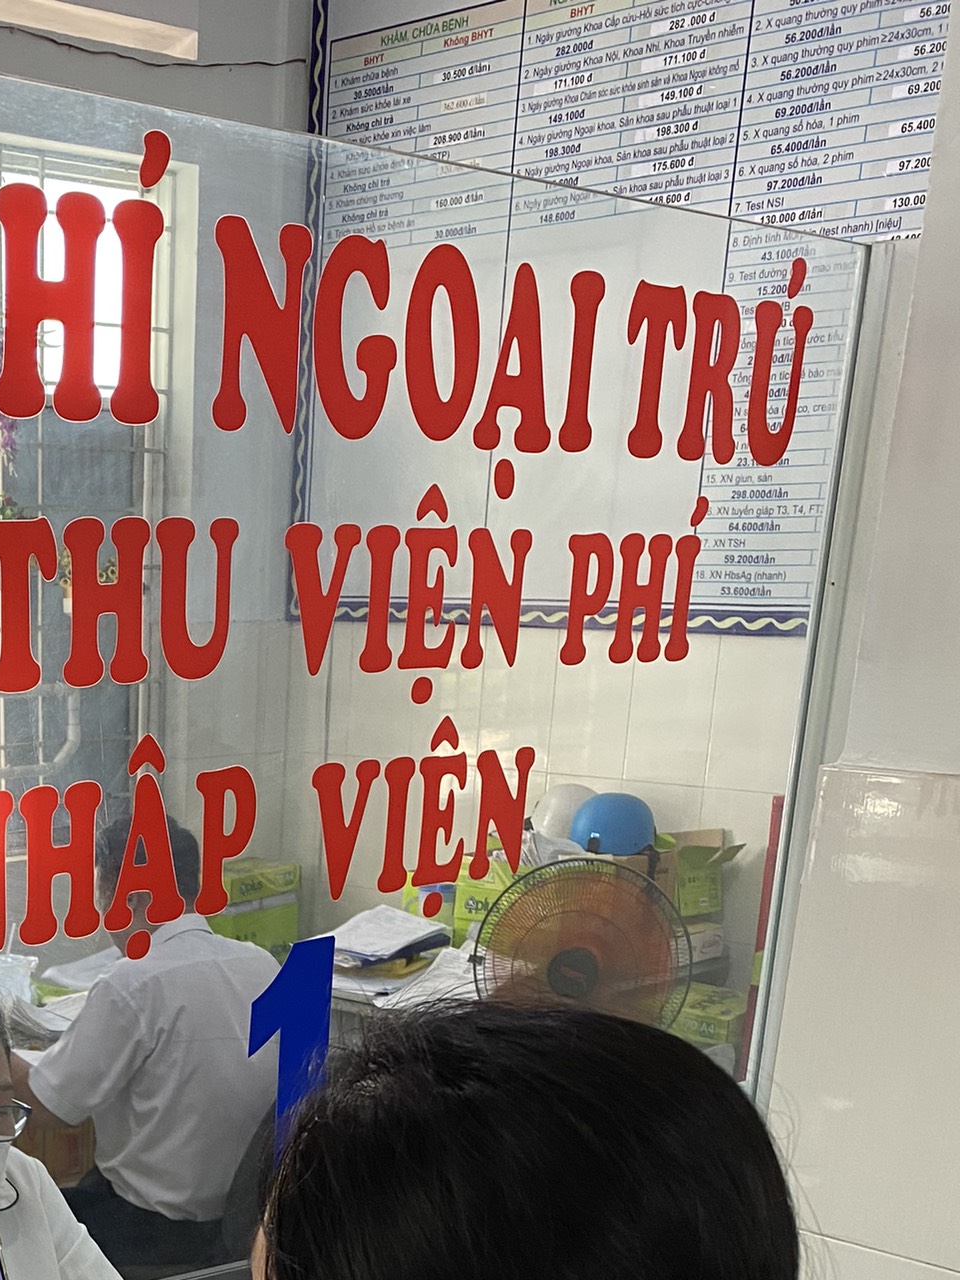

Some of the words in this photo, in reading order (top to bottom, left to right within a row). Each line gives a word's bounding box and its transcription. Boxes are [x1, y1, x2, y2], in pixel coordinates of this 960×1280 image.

[570, 5, 595, 18] BHYT
[708, 11, 716, 22] đ
[443, 35, 469, 48] Không
[471, 28, 494, 41] BHYT
[785, 26, 842, 44] 56.200đ/lần
[556, 40, 593, 57] 282.000đ
[364, 54, 384, 66] BHYT
[663, 52, 697, 66] 171.100
[699, 49, 706, 59] đ
[442, 68, 466, 81] 30.500
[780, 63, 837, 81] 56.200đ/lần
[554, 75, 585, 89] 171.100
[587, 73, 593, 82] đ
[660, 87, 694, 102] 149.100
[696, 85, 703, 94] đ
[548, 109, 585, 124] 149.100đ
[775, 101, 832, 118] 69.200đ/lần
[656, 123, 690, 138] 198.300
[692, 121, 698, 130] đ
[901, 119, 935, 133] 65.400
[545, 144, 581, 158] 198.300đ
[770, 138, 826, 155] 65.400đ/lần
[653, 159, 686, 172] 175.600
[688, 157, 694, 166] đ
[766, 176, 822, 191] 97.200đ/lần
[746, 200, 764, 211] Test
[760, 212, 795, 225] 130.000
[212, 214, 607, 500] NGOẠI
[626, 258, 814, 467] TRÚ
[731, 488, 789, 499] 298.000đ/lần
[729, 521, 780, 531] 64.600đ/lần
[713, 539, 726, 547] XN
[728, 538, 745, 547] TSH
[724, 554, 775, 564] 59.200đ/lần
[285, 483, 533, 704] VIỆN
[559, 496, 710, 667] PHÍ
[720, 586, 771, 596] 53.600đ/lần
[311, 716, 536, 917] VIỆN
[247, 935, 336, 1165] 1
